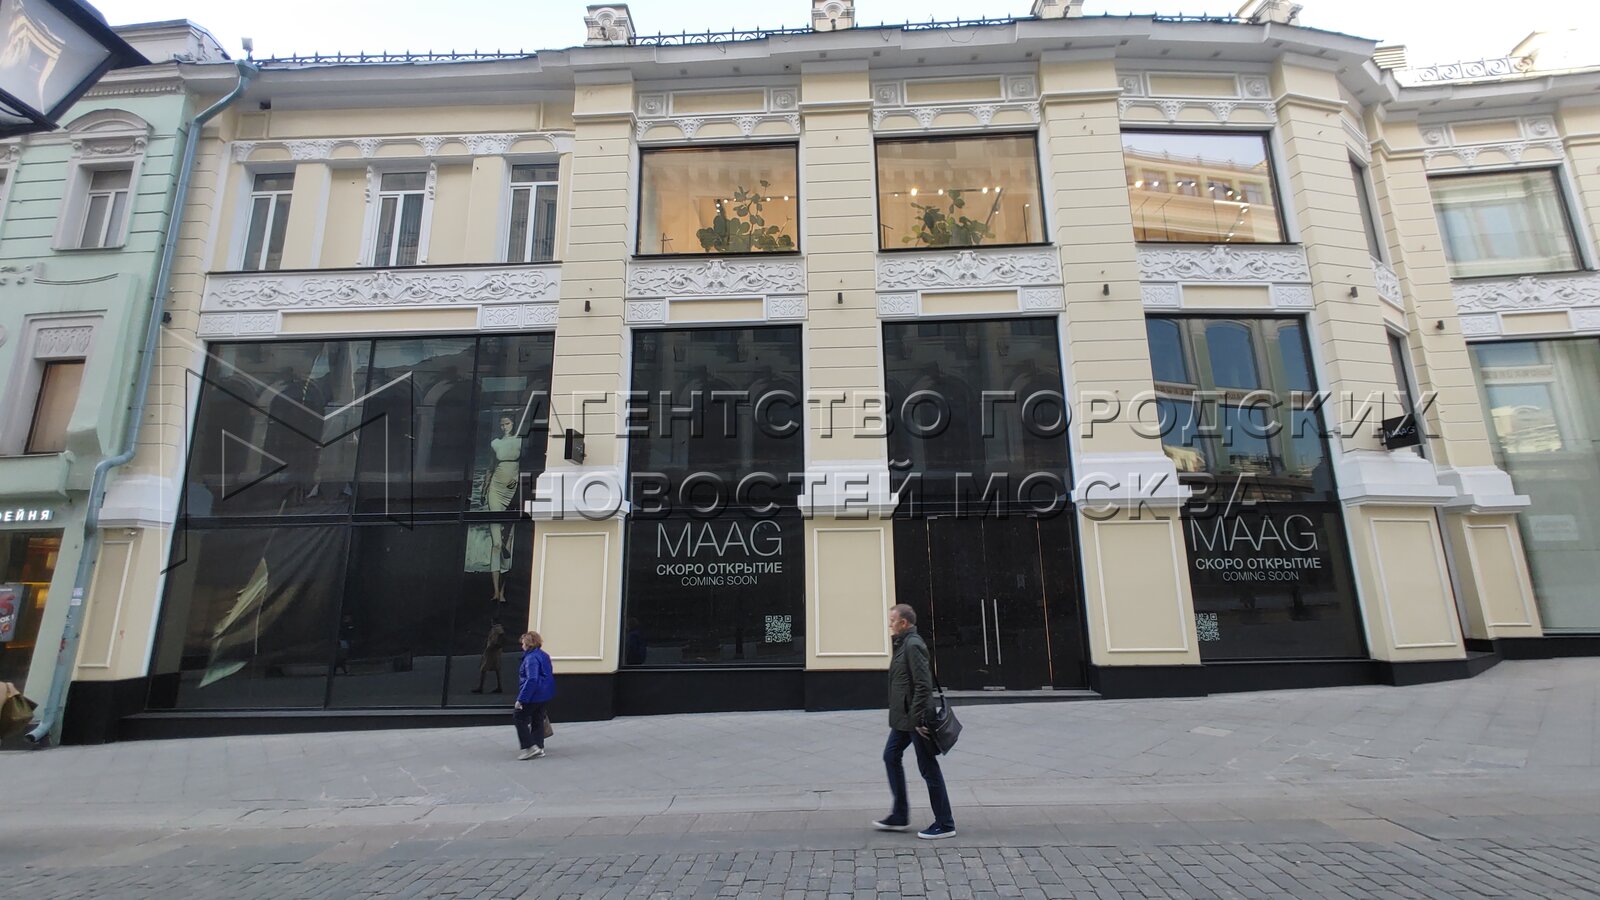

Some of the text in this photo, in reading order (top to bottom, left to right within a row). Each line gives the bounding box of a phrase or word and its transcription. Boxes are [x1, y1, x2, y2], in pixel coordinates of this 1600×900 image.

[0, 508, 50, 521] ЕЙНЯ
[656, 520, 782, 558] MAAG
[1190, 514, 1319, 551] MAAG
[656, 561, 783, 576] СКОРО ОТКРЫТИЕ
[1195, 557, 1322, 570] СКОРО ОТКРЫТИЕ
[681, 575, 758, 587] COMING SOON
[1222, 570, 1299, 582] COMING SOON
